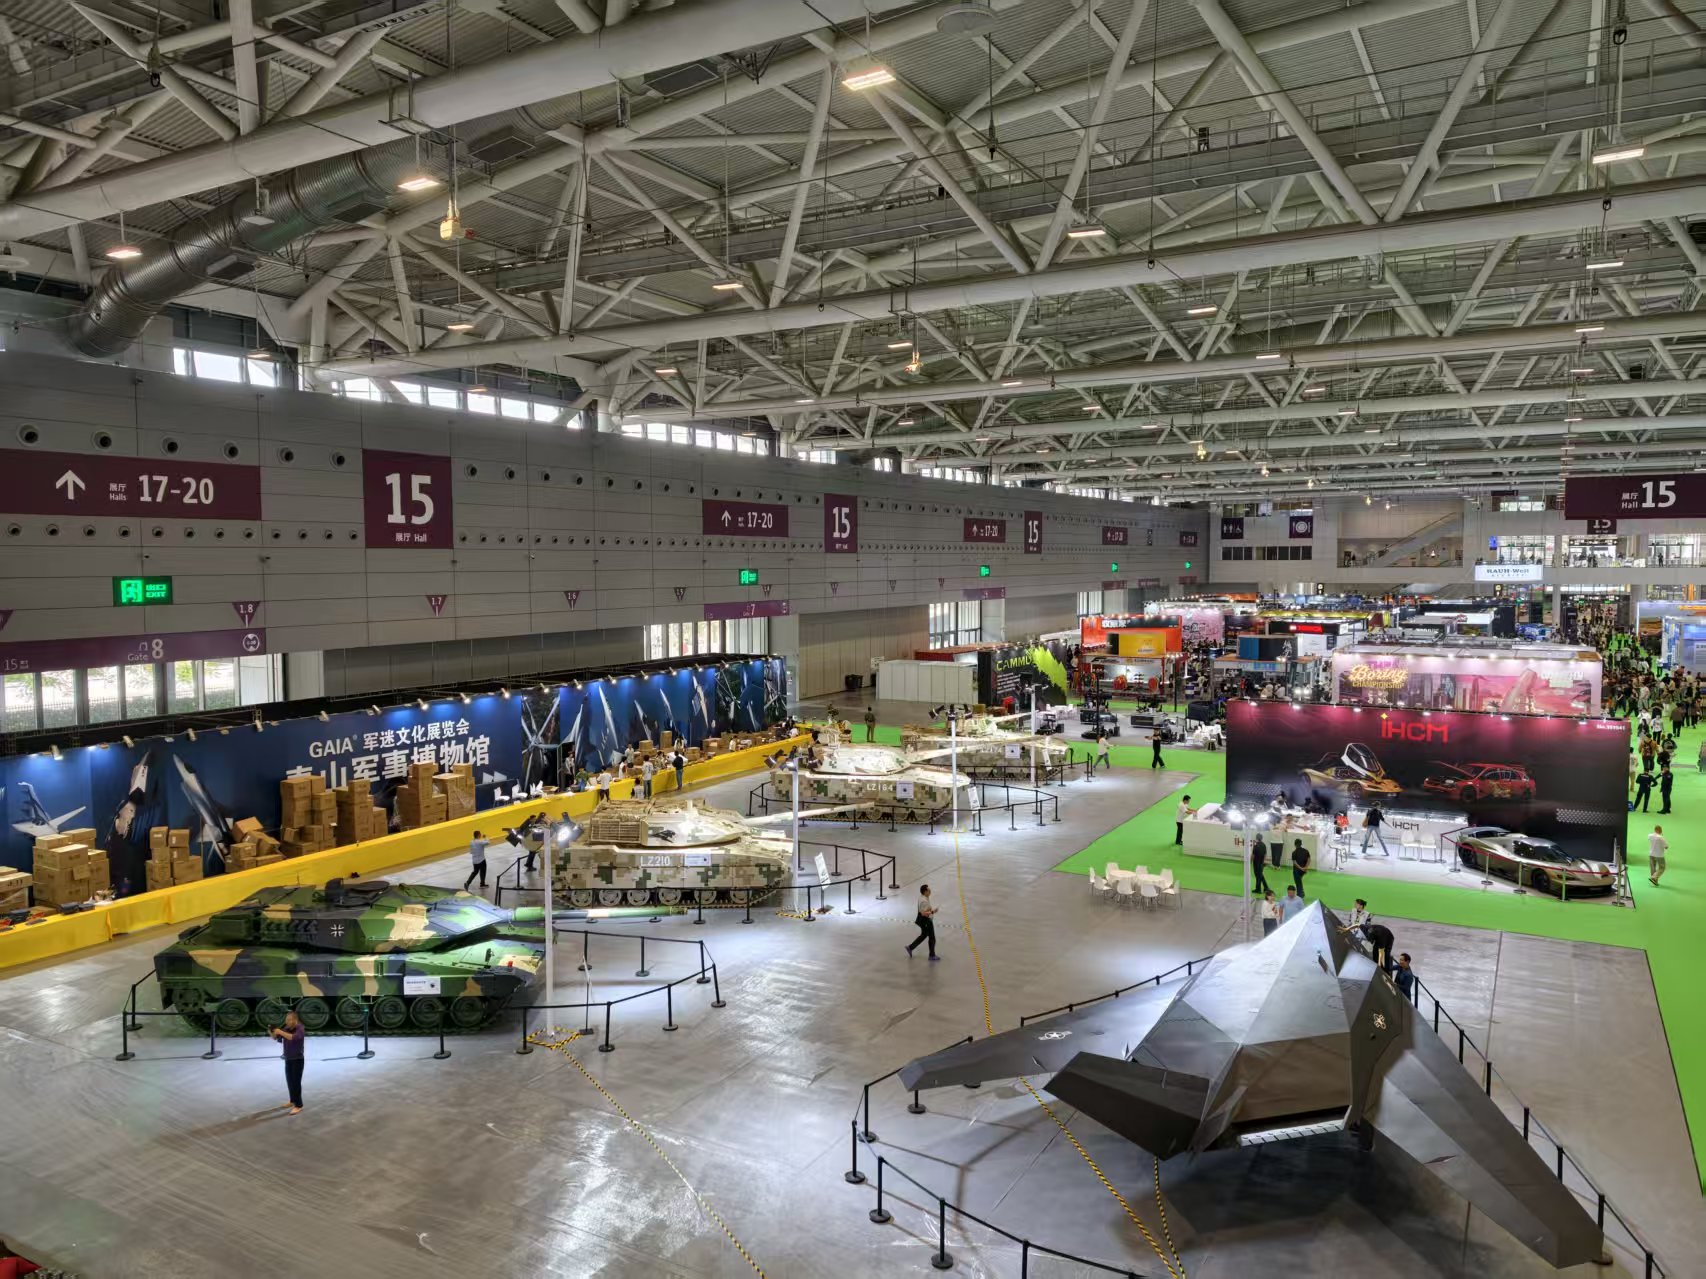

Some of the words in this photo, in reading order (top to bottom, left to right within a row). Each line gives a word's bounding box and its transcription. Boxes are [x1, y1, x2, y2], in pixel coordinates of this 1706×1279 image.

[109, 493, 126, 501] Halls
[139, 475, 214, 504] 17-20
[1641, 481, 1677, 508] 15
[385, 472, 434, 525] 15
[1621, 501, 1638, 509] Hall
[747, 512, 773, 529] 17-20
[832, 507, 851, 539] 15
[414, 533, 427, 542] Hall
[1028, 520, 1039, 543] 15
[239, 604, 254, 614] 1.8
[750, 603, 756, 616] 7
[152, 638, 164, 660] 8
[4, 658, 18, 671] 15
[127, 653, 149, 662] Gate
[363, 718, 470, 751] 军迷文化展览会
[640, 855, 671, 867] LZ210
